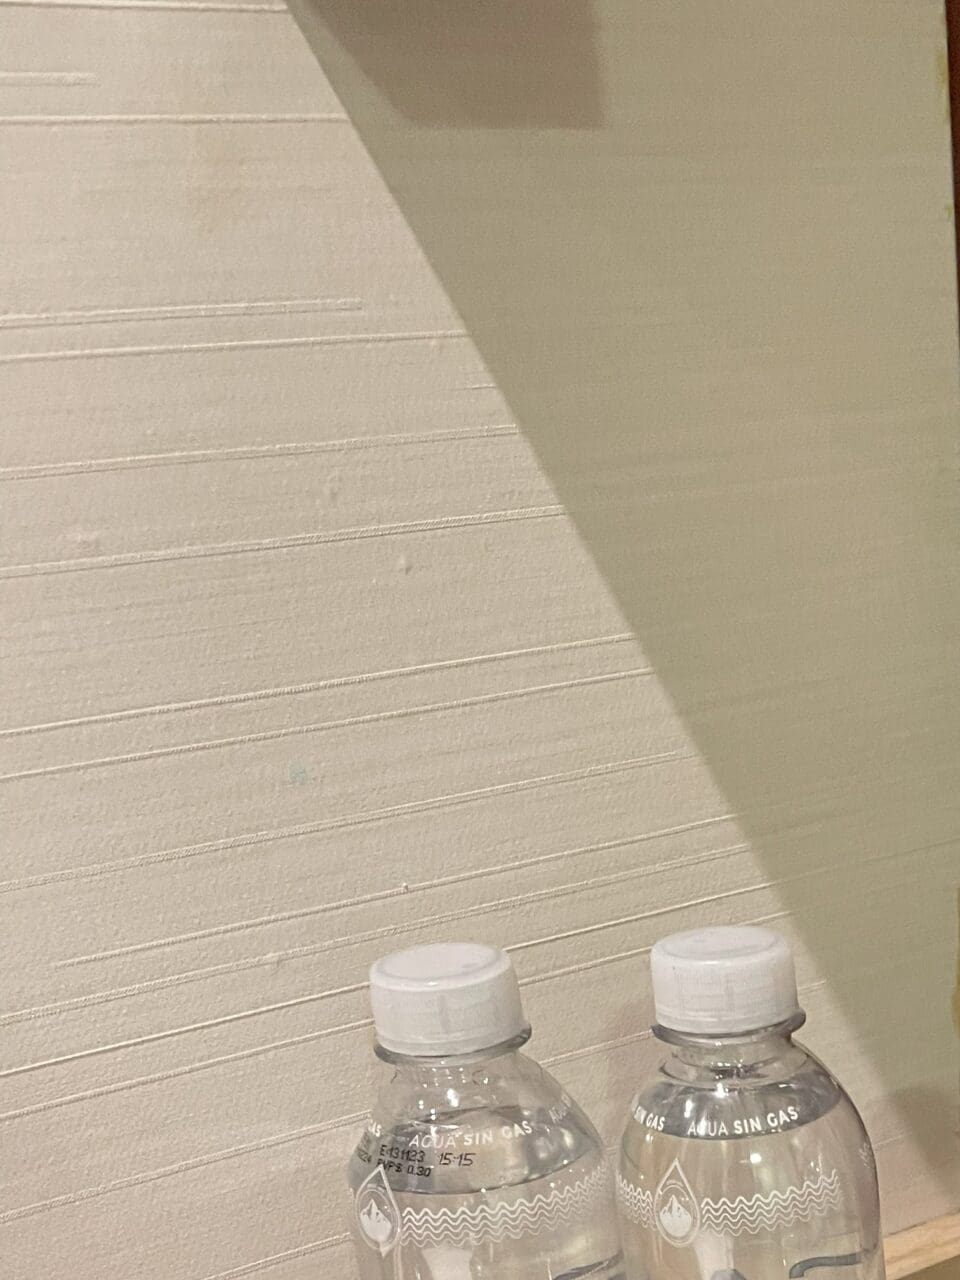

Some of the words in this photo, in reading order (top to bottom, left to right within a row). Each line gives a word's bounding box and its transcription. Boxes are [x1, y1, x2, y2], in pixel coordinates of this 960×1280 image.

[464, 1129, 493, 1146] SIN
[502, 1120, 533, 1140] GAS
[646, 1112, 665, 1132] GAS
[733, 1116, 762, 1135] SIN
[766, 1106, 798, 1128] GAS
